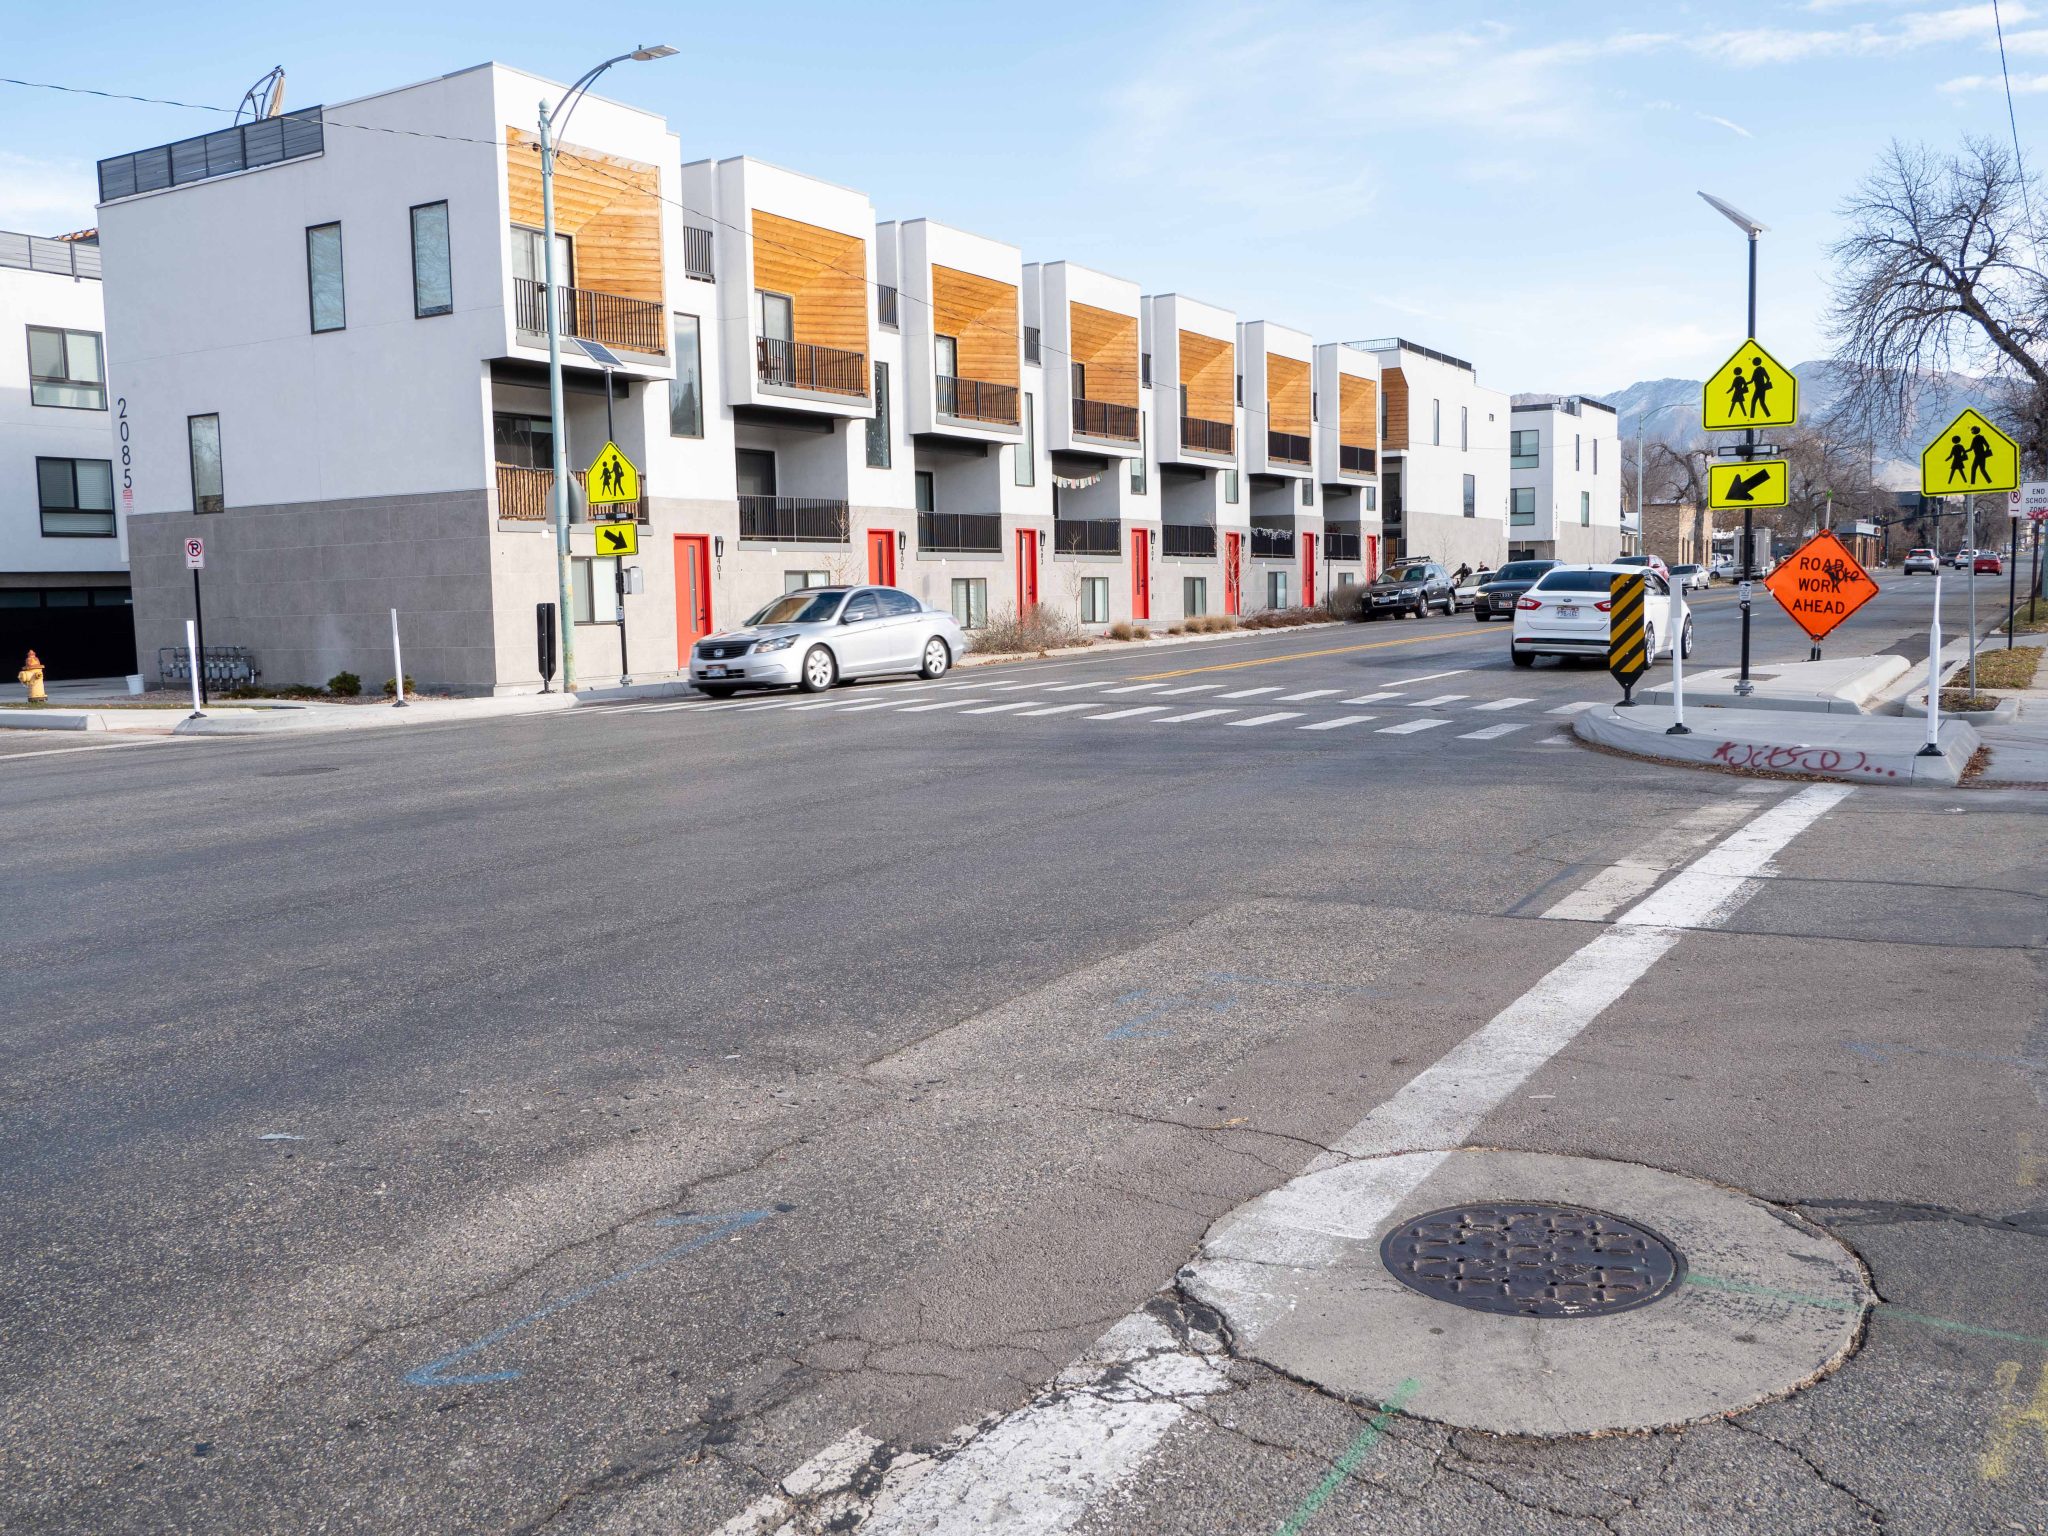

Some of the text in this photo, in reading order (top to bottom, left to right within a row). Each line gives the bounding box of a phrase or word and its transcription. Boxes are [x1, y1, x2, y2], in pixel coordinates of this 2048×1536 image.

[117, 397, 132, 489] 2085
[1800, 556, 1845, 573] ROAD
[1798, 577, 1841, 594] WORK
[1791, 598, 1846, 615] AHEAD
